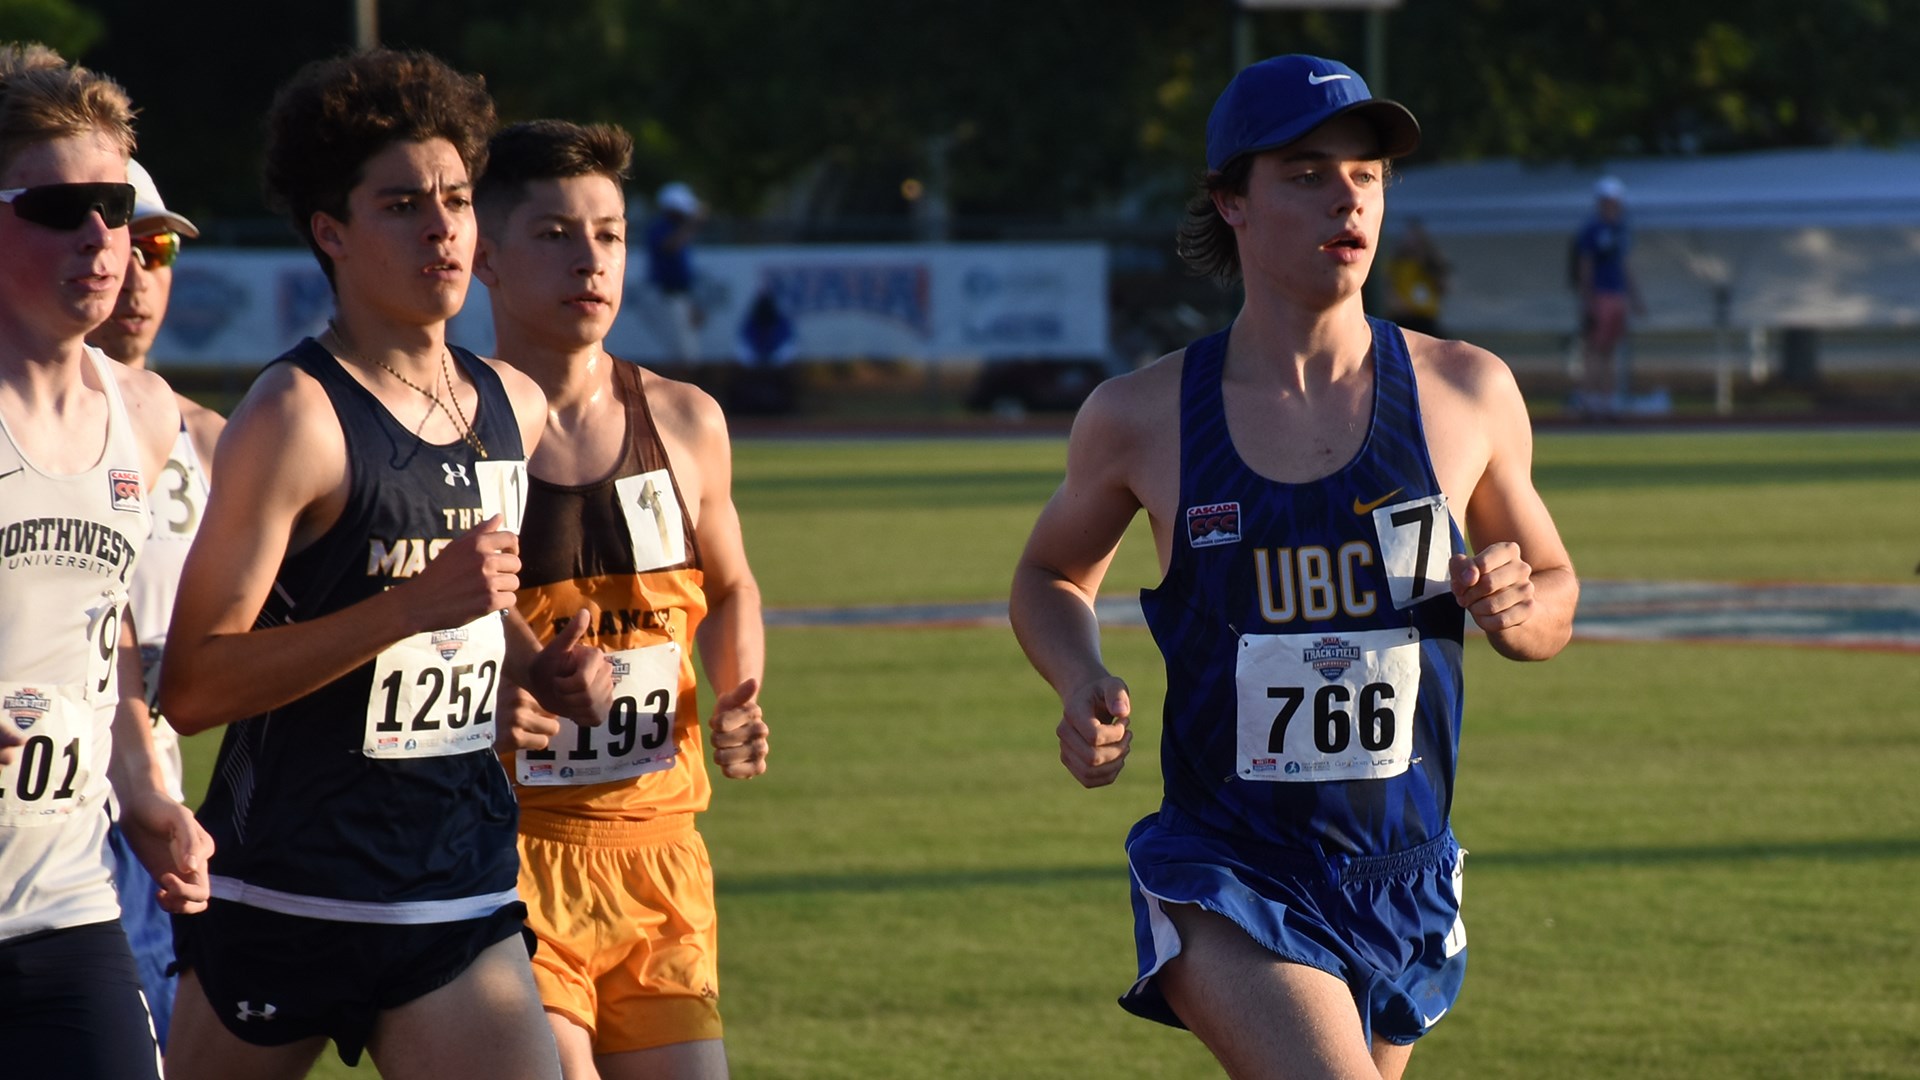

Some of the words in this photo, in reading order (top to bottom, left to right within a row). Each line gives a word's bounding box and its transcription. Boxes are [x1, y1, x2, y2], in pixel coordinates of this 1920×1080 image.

[163, 459, 196, 534] 3
[442, 508, 483, 530] THE
[1188, 503, 1238, 515] CASCADE
[1191, 514, 1237, 535] CCC
[8, 555, 113, 578] UNIVERSITY
[1253, 540, 1378, 624] UBC
[1391, 504, 1434, 600] 7
[98, 606, 117, 693] 9
[375, 659, 497, 732] 1252
[526, 688, 670, 760] 193
[1267, 682, 1396, 754] 766
[0, 735, 79, 801] 01
[1371, 758, 1394, 766] UCS
